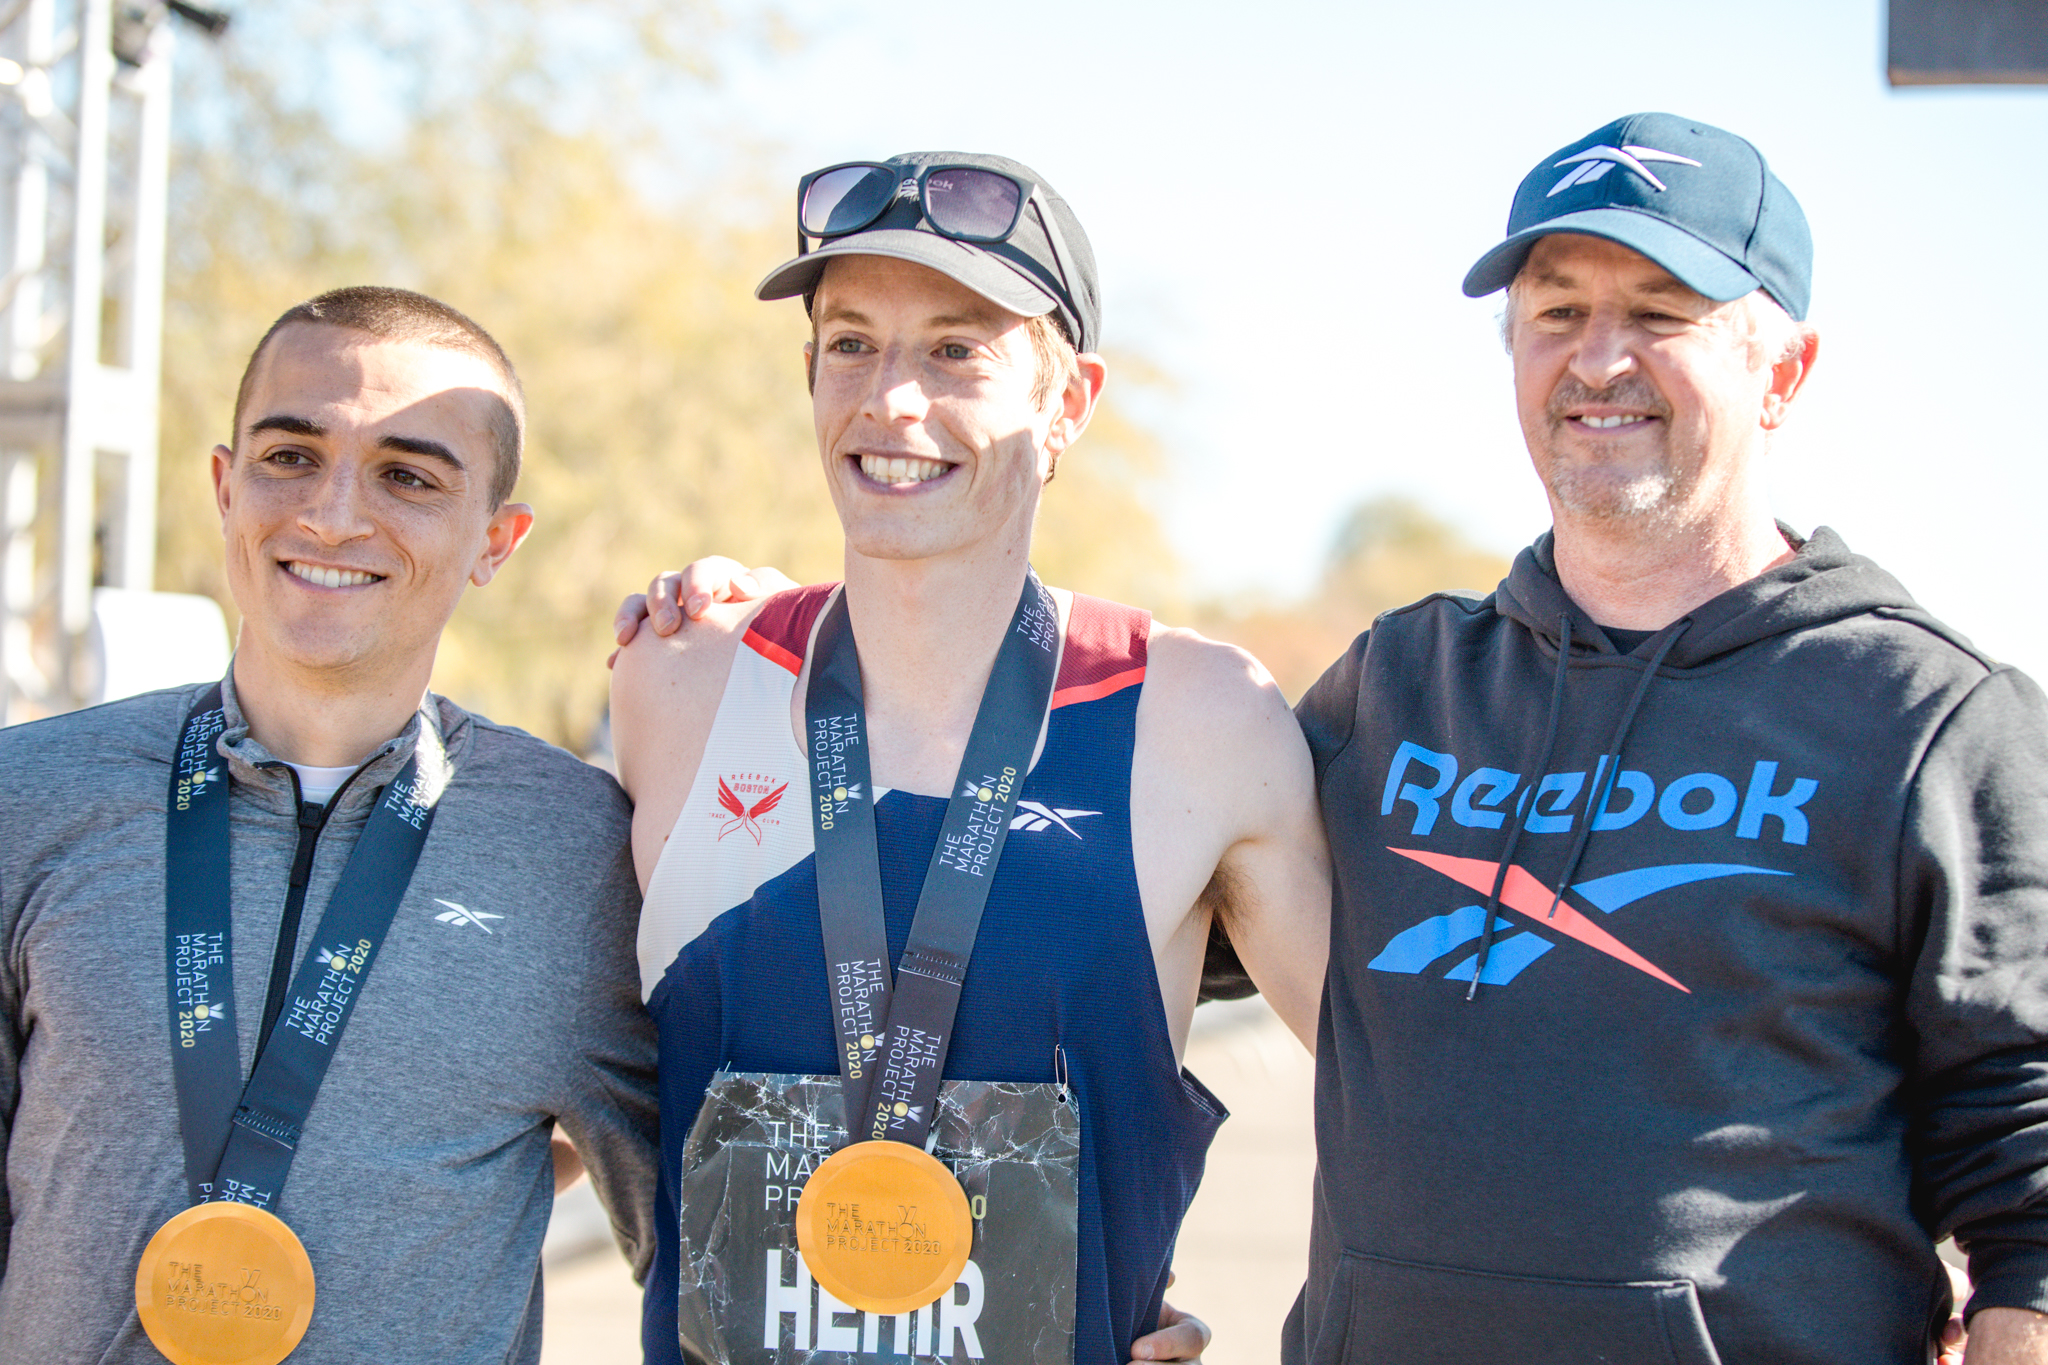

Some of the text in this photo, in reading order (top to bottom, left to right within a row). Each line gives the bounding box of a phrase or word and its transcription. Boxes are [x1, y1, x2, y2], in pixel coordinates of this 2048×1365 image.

[1016, 604, 1035, 634] THE
[210, 706, 225, 736] THE
[844, 713, 859, 747] THE
[176, 716, 202, 811] PROJECT 2020
[731, 773, 776, 784] REEBOK
[814, 719, 834, 831] PROJECT 2020
[384, 780, 409, 812] THE
[733, 783, 770, 794] BOSTON
[1380, 740, 1820, 846] Reebok
[762, 818, 780, 826] CLUB
[970, 766, 1017, 877] PROJECT 2020
[939, 833, 961, 866] THE
[208, 932, 223, 965] THE
[175, 934, 196, 1048] PROJECT 2020
[866, 958, 885, 993] THE
[315, 939, 372, 1046] PROJECT 2020
[285, 996, 311, 1029] THE
[836, 962, 863, 1080] PROJECT 2020
[920, 1035, 942, 1068] THE
[871, 1025, 910, 1140] PROJECT 2020
[768, 1121, 831, 1150] THE
[826, 1203, 860, 1219] THE
[826, 1235, 941, 1256] PROJECT 2020
[169, 1261, 203, 1280] THE
[165, 1295, 283, 1322] PROJECT 2020
